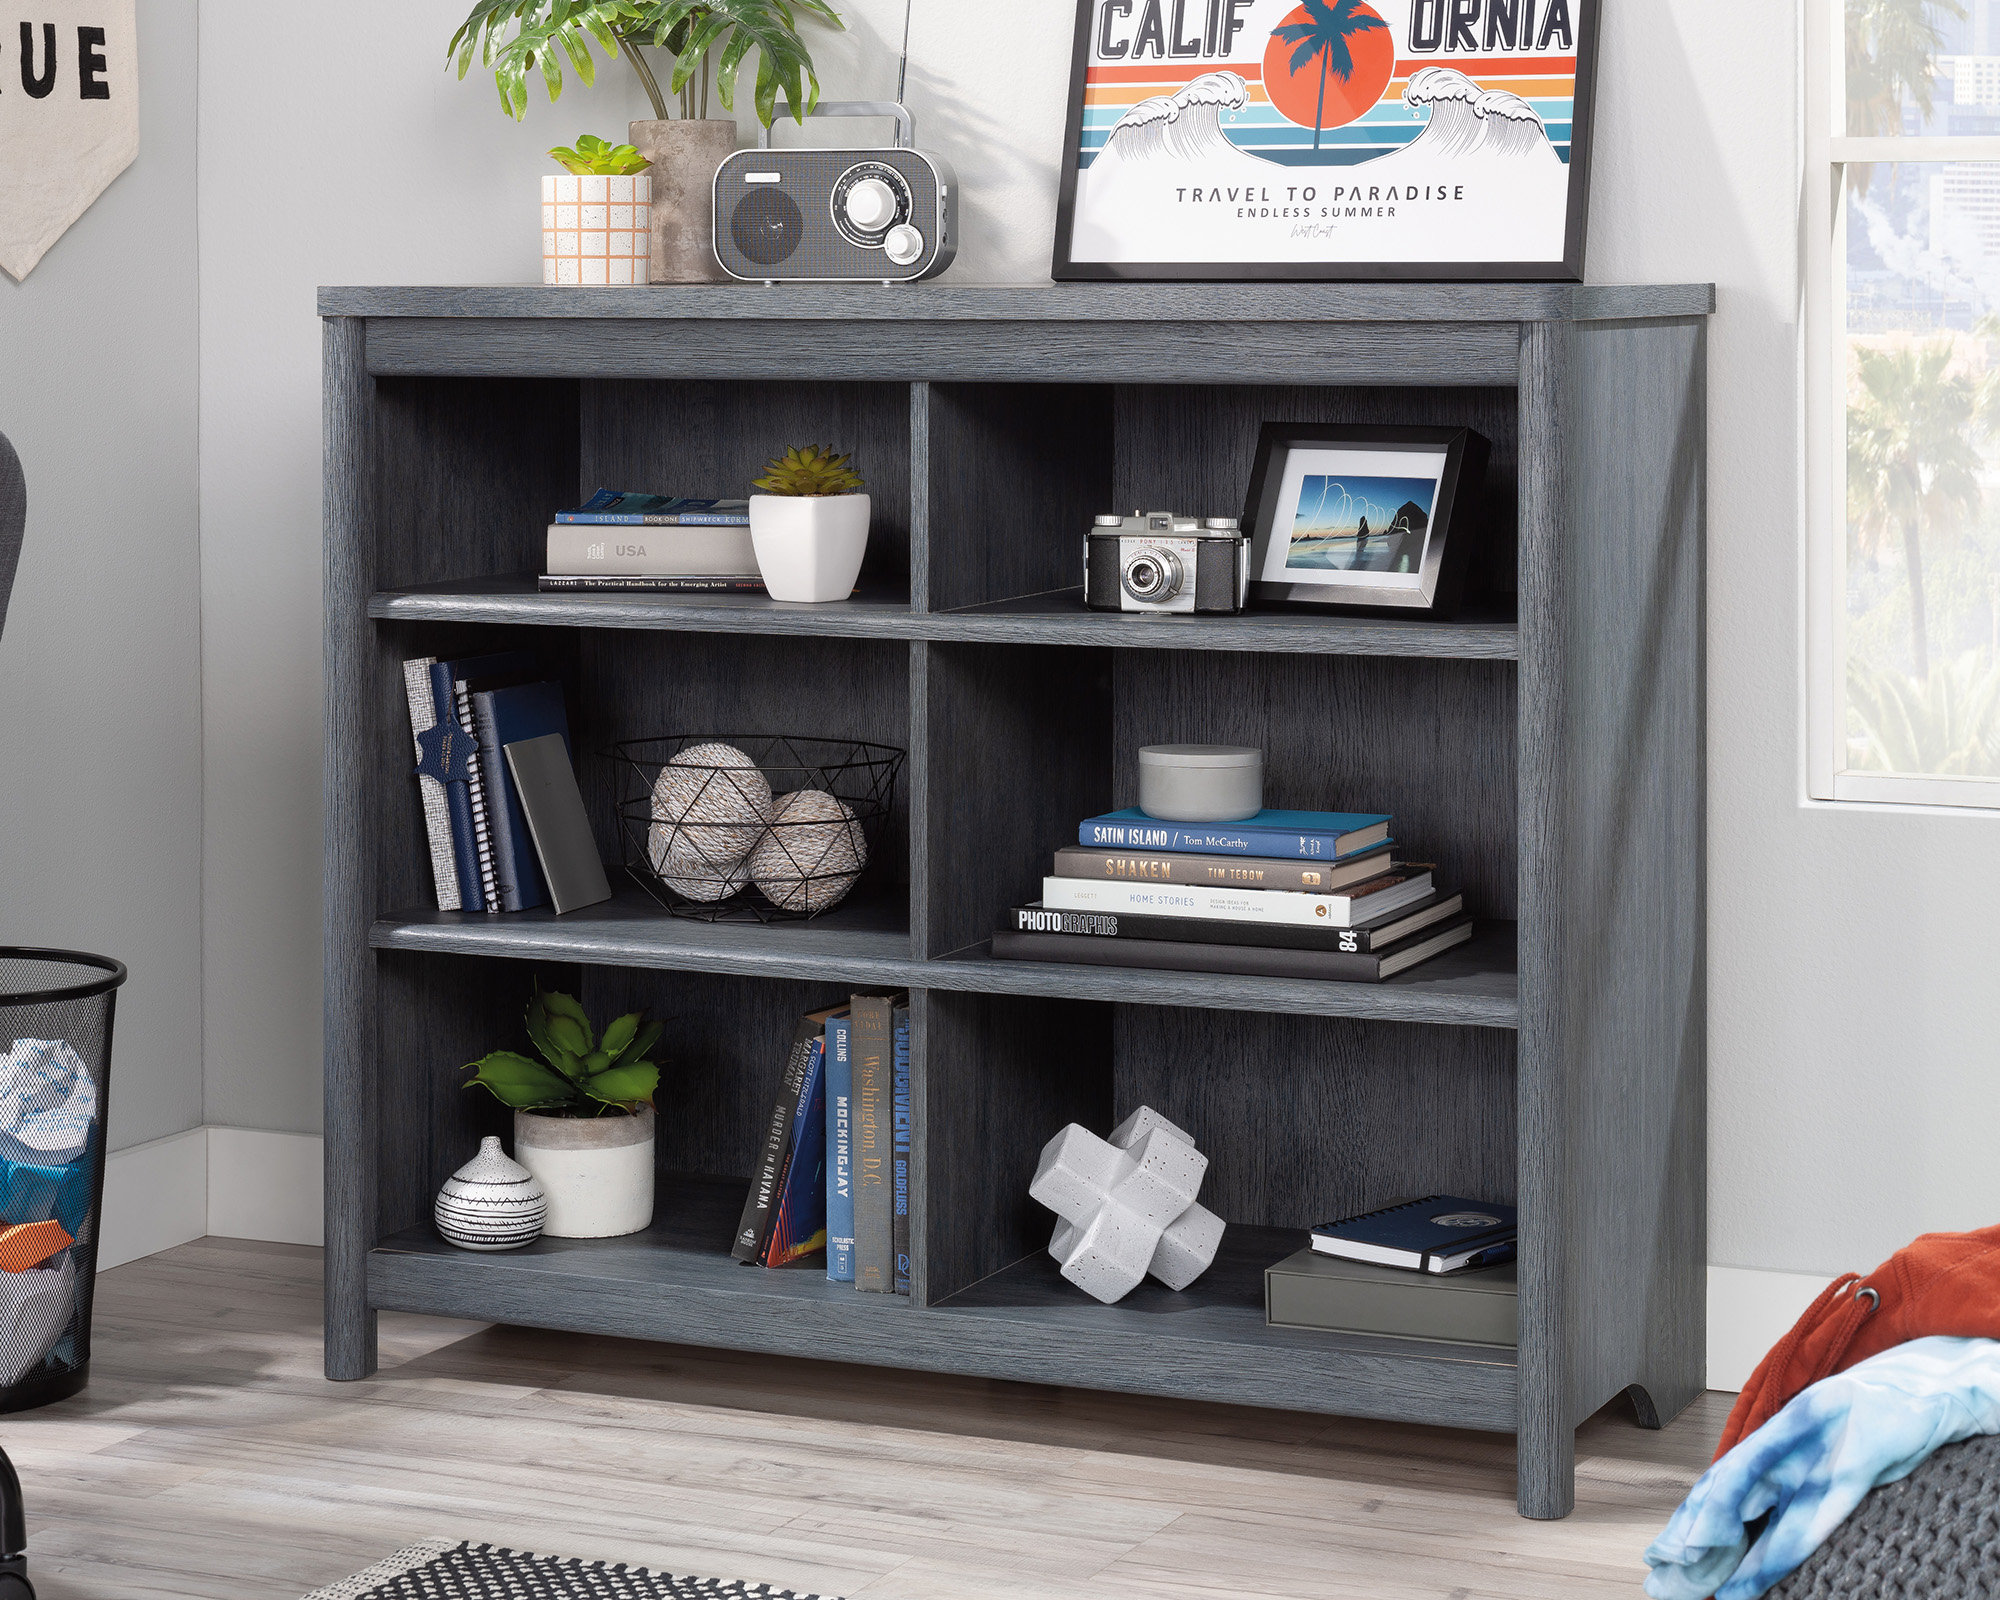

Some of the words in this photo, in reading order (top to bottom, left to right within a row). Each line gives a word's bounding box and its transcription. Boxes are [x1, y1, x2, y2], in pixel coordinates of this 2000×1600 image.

[1097, 0, 1254, 59] CALIF
[1408, 0, 1573, 53] ORNIA
[0, 21, 110, 100] UE
[1176, 187, 1270, 202] TRAVEL
[1286, 186, 1317, 201] TO
[1333, 185, 1464, 201] PARADISE
[1236, 207, 1311, 218] ENDLESS
[1320, 206, 1397, 217] SUMMER
[616, 545, 647, 557] USA
[1093, 826, 1125, 844] SATIN
[1128, 828, 1168, 847] ISLAND
[1184, 835, 1203, 846] Tom
[1206, 836, 1248, 850] McCarthy
[1105, 858, 1171, 879] SHAKEN
[1208, 867, 1226, 879] TIM
[1230, 868, 1264, 881] TEBOW
[1130, 894, 1154, 904] HOME
[1158, 895, 1195, 907] STORIES
[1018, 910, 1118, 936] PHOTOGRAPHIS
[1339, 930, 1358, 952] 84
[836, 1028, 847, 1062] COLLINS
[784, 1042, 802, 1086] TRUMAN
[791, 1038, 813, 1096] MARGARET
[806, 1055, 816, 1077] SCOTT
[858, 1056, 880, 1153] Washington,
[768, 1105, 787, 1150] MURDER
[767, 1153, 776, 1163] IN
[837, 1096, 848, 1198] MOCKINGJAY
[863, 1157, 882, 1186] D.C.
[756, 1165, 775, 1209] HAVANA
[896, 1160, 907, 1215] GOLDFLUSS
